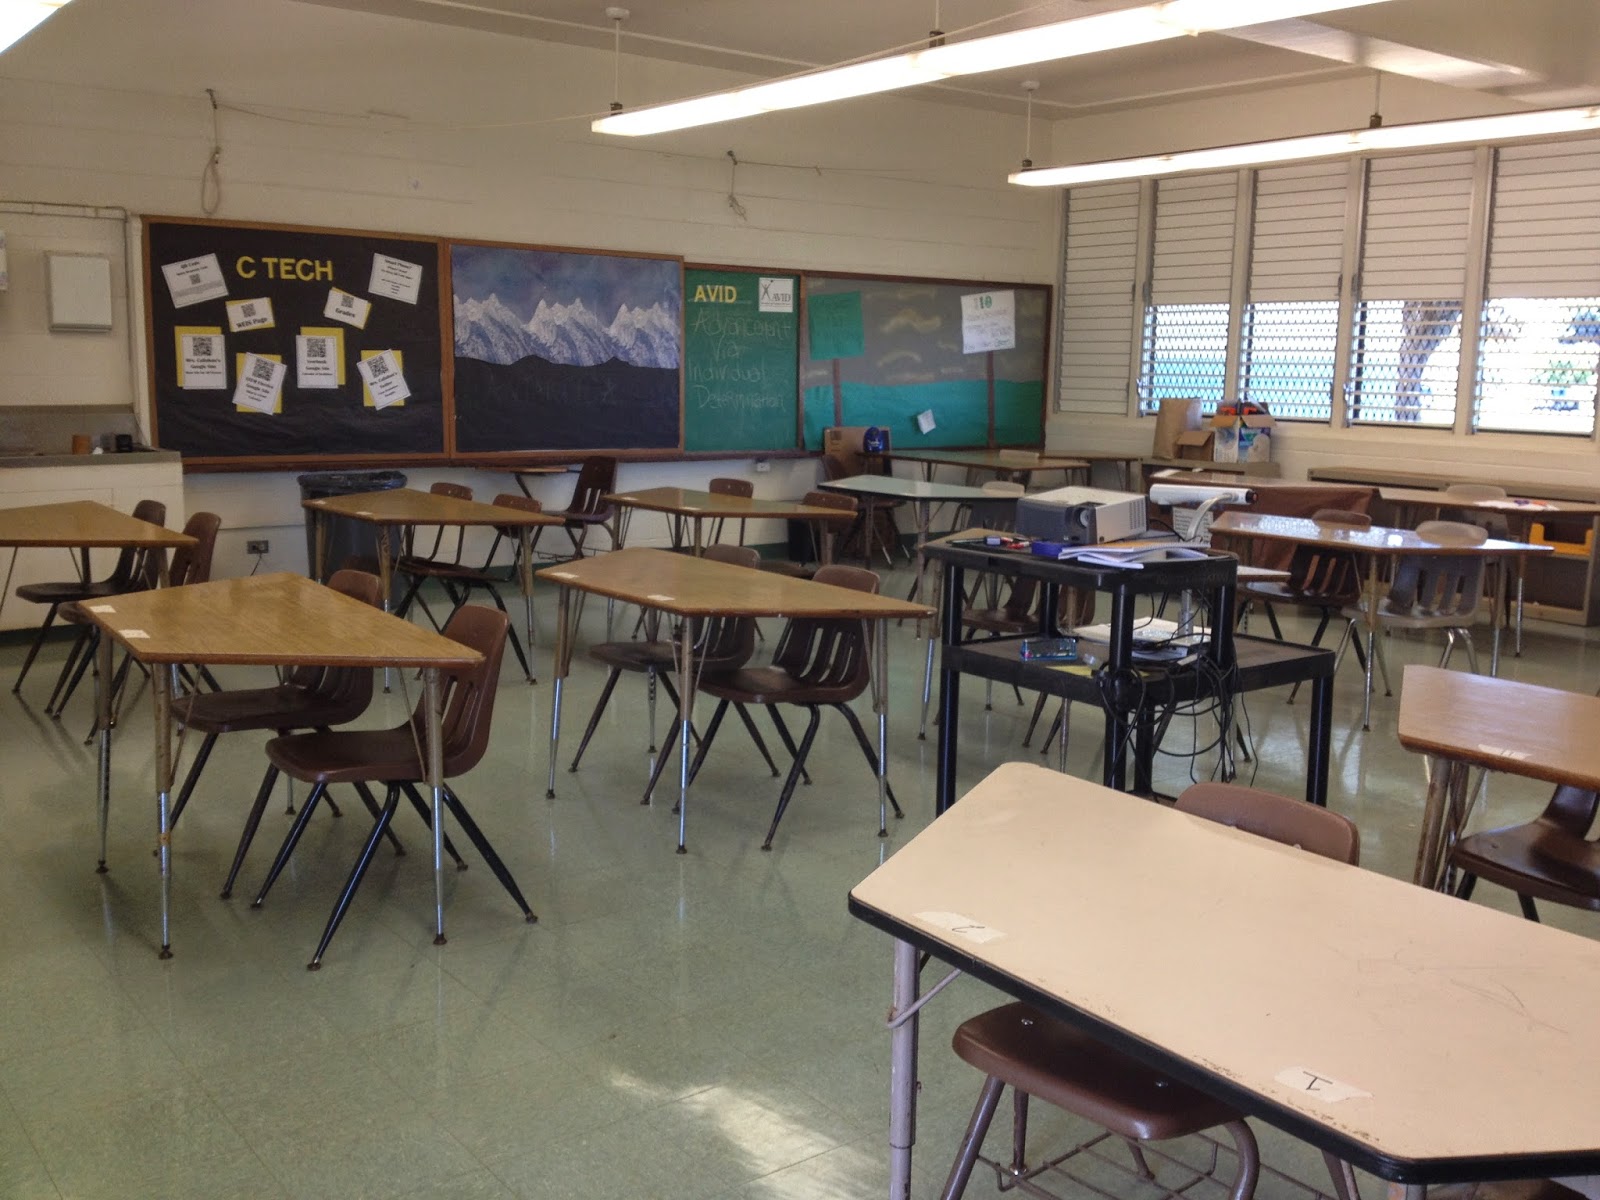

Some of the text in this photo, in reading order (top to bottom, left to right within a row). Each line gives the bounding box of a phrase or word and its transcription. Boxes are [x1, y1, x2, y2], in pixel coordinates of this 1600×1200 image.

[235, 255, 257, 280] C
[261, 257, 333, 282] TECH
[693, 284, 738, 304] AVID
[772, 293, 792, 302] AVID
[335, 307, 356, 318] Grades
